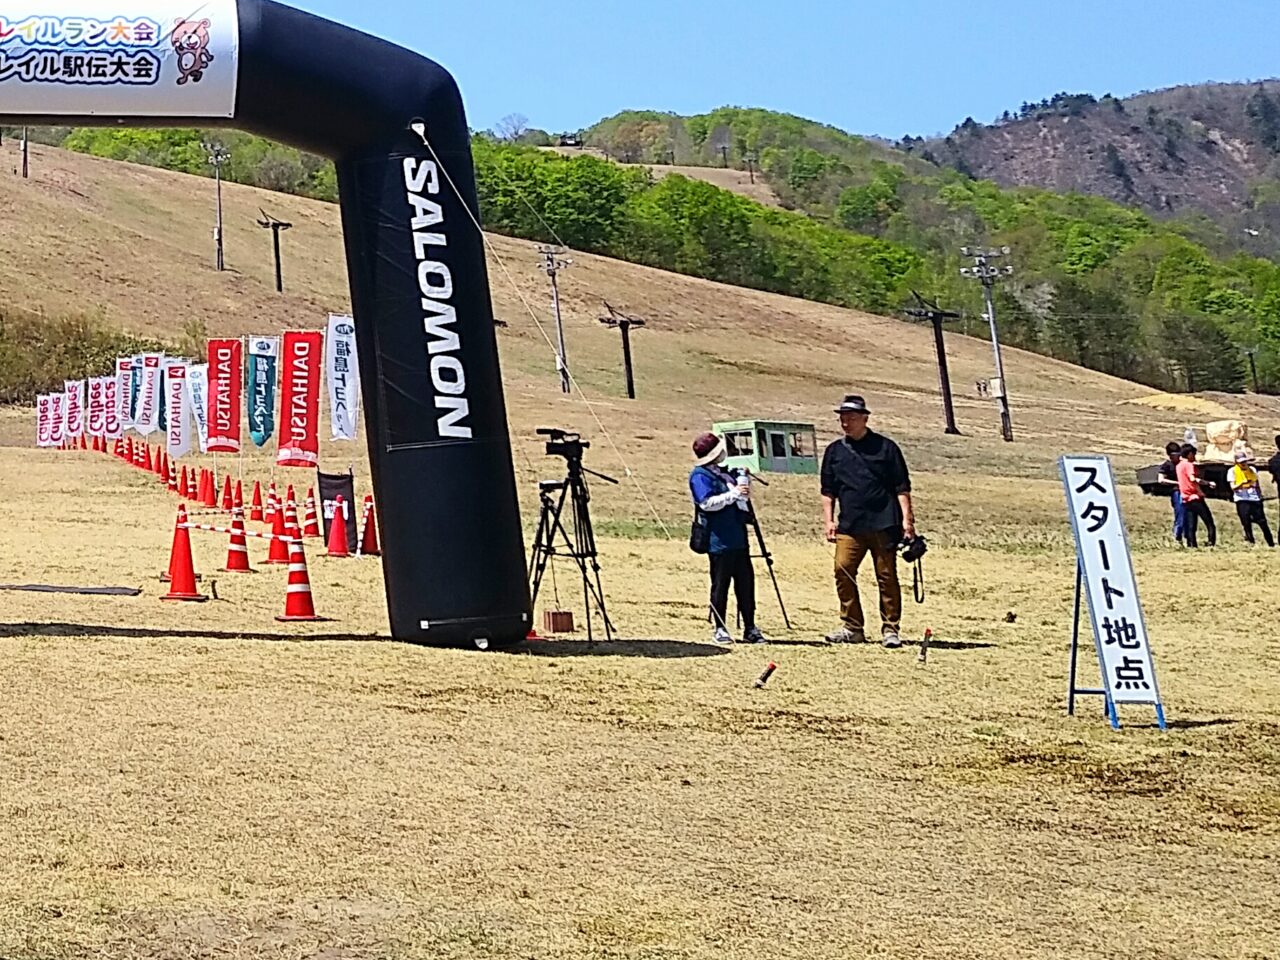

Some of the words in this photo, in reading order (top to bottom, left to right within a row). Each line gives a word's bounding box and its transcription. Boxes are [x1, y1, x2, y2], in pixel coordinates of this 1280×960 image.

[403, 157, 472, 439] SALOMON
[1073, 466, 1150, 690] スタート地点
